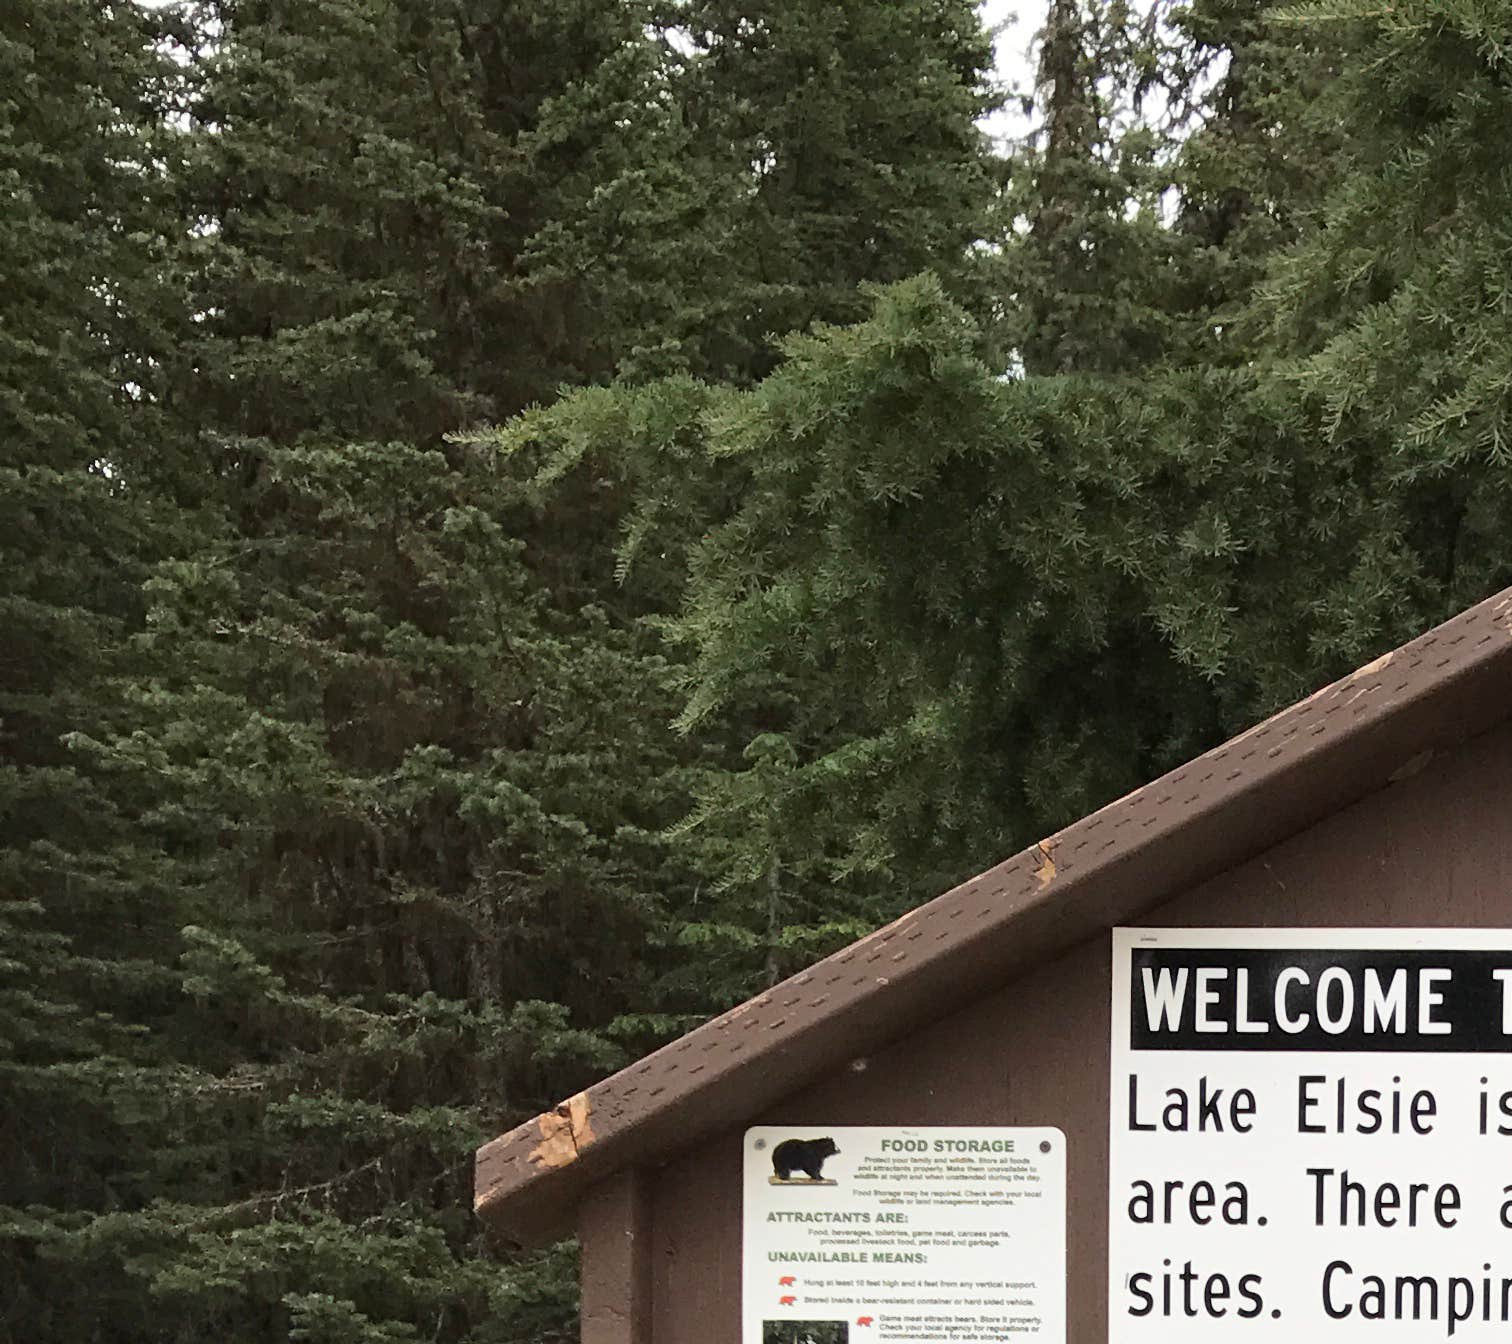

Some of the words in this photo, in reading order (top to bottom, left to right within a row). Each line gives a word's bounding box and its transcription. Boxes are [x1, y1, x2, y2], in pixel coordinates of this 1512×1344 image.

[1142, 967, 1451, 1034] WELCOME
[1129, 1074, 1256, 1133] Lake
[1298, 1076, 1436, 1134] Elsie
[881, 1139, 929, 1153] FOOD
[934, 1139, 1015, 1153] STORAGE
[767, 1212, 870, 1224] ATTRACTANTS
[875, 1212, 908, 1224] ARE:
[1128, 1180, 1267, 1226] area.
[1307, 1169, 1460, 1228] There
[768, 1252, 868, 1263] UNAVAILABLE
[873, 1252, 927, 1264] MEANS:
[1128, 1259, 1281, 1318] sites.
